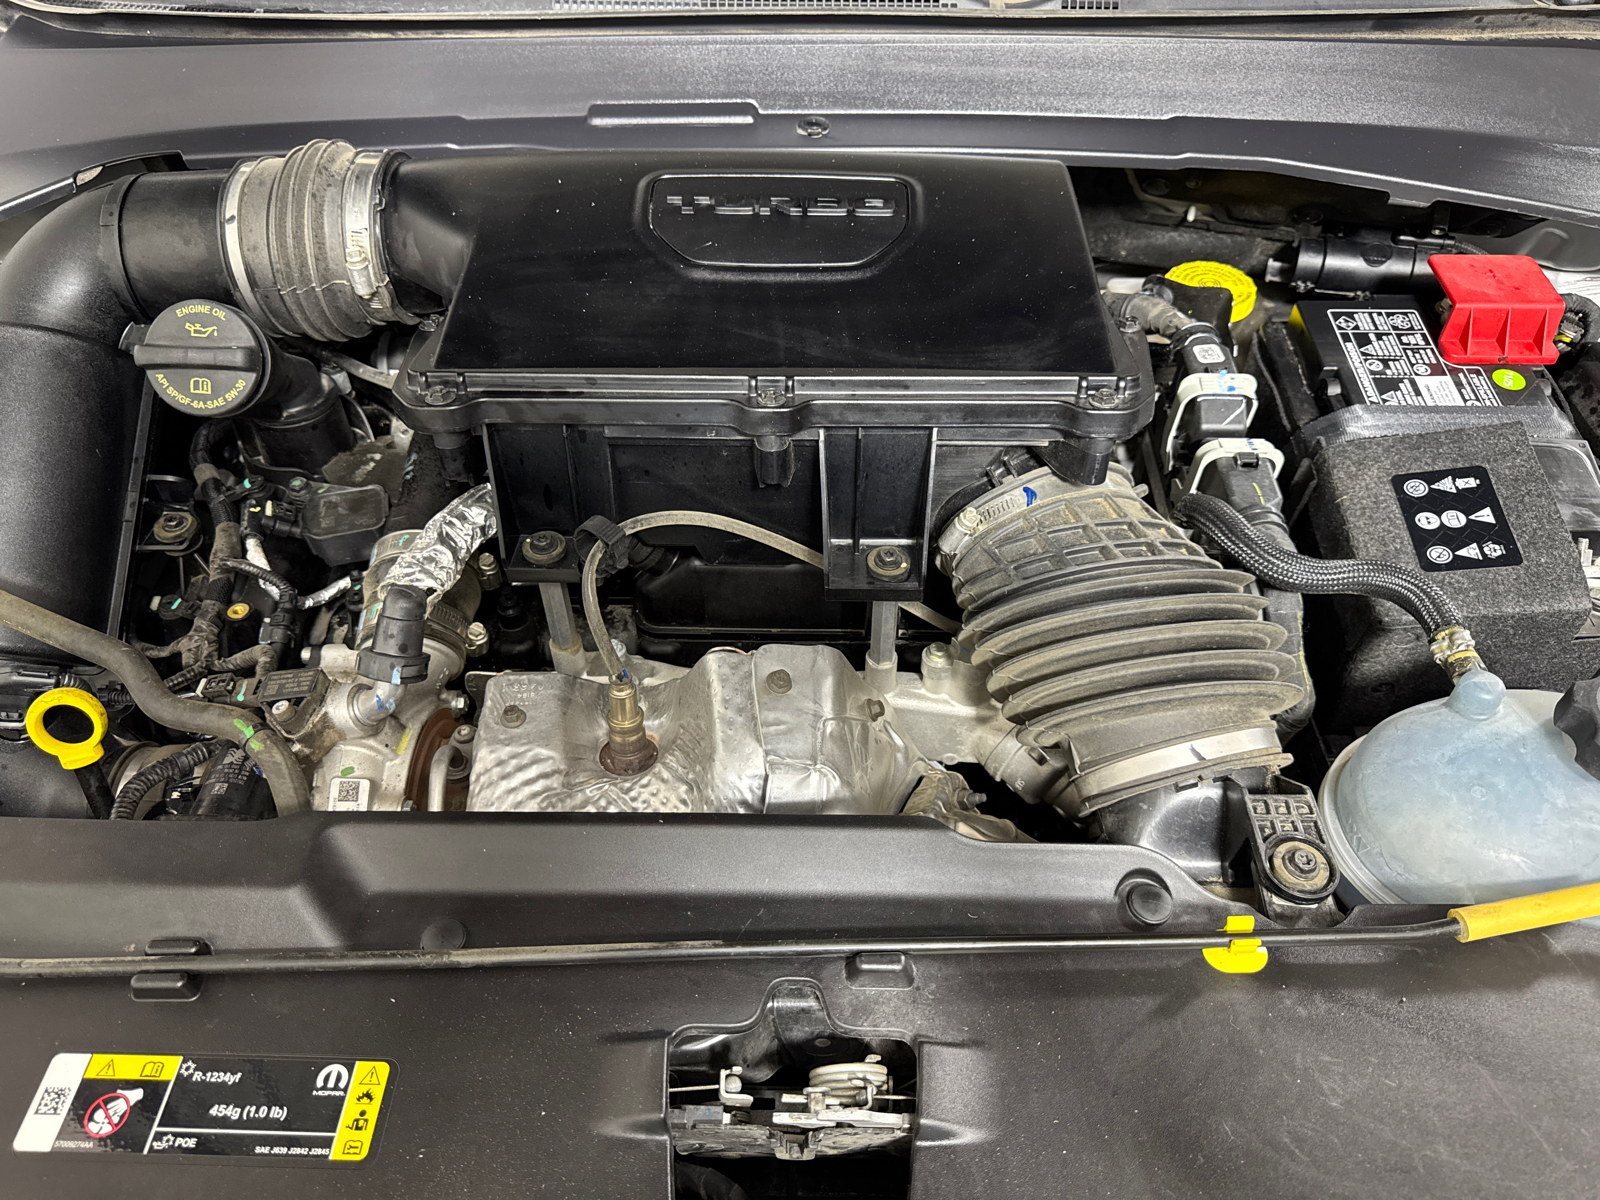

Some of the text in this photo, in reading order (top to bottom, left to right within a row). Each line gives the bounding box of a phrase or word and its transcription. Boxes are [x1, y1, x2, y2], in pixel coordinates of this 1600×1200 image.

[666, 195, 896, 217] TURBO
[176, 305, 227, 321] ENGINE OIL
[156, 373, 246, 409] API SP/GF-6A-SAE 5W-30
[192, 1072, 242, 1086] R-1234yf
[208, 1104, 288, 1120] 454g (1.0 lb)
[174, 1138, 198, 1148] POE
[254, 1146, 330, 1155] SAE J639 J2842 J2845
